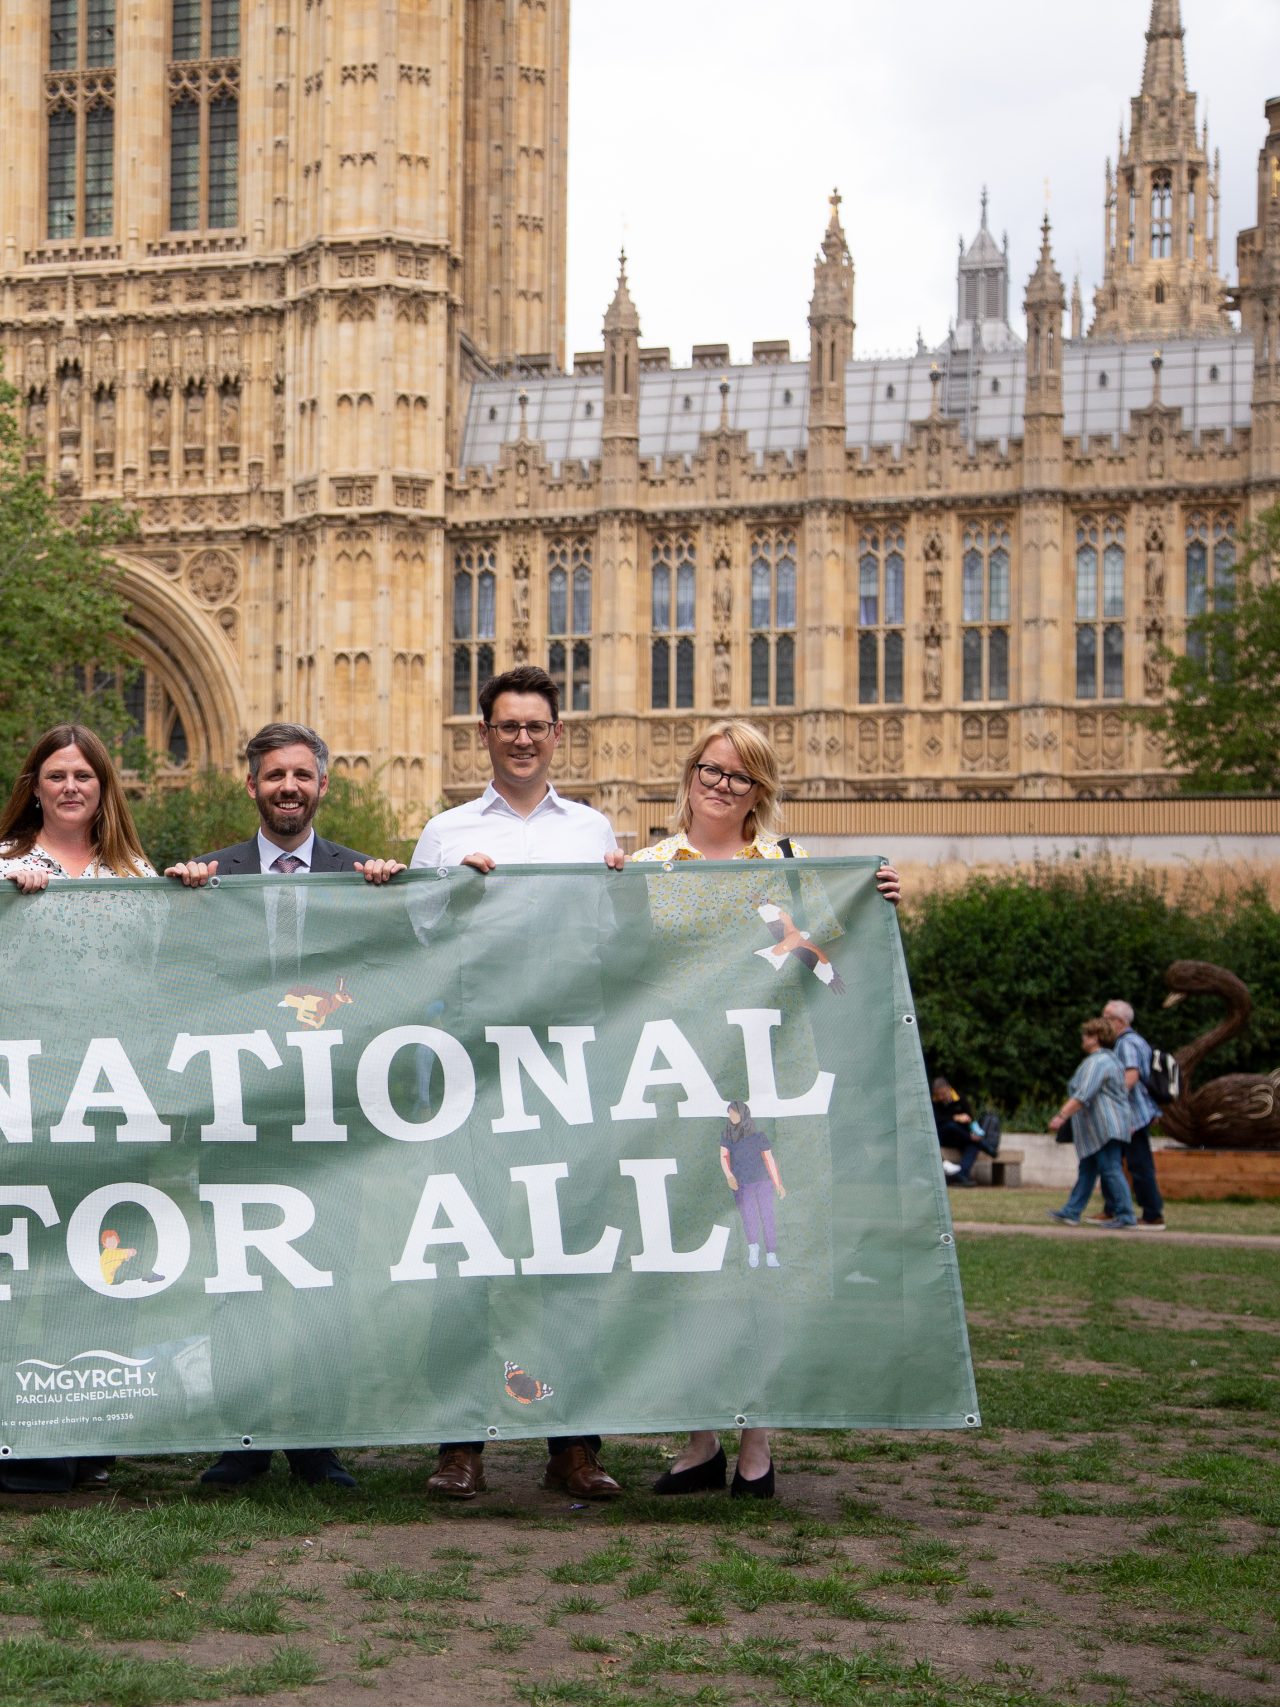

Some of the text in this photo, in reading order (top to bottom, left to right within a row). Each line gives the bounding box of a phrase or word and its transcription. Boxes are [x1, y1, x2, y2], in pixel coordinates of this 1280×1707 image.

[390, 1158, 731, 1281] ALL
[15, 1366, 157, 1391] YMGYRCH y
[16, 1387, 158, 1404] PARCIAU CENEDLAETHOL
[1, 1419, 8, 1427] is
[18, 1417, 59, 1428] registered
[61, 1416, 90, 1424] charity
[106, 1412, 134, 1421] 295336
